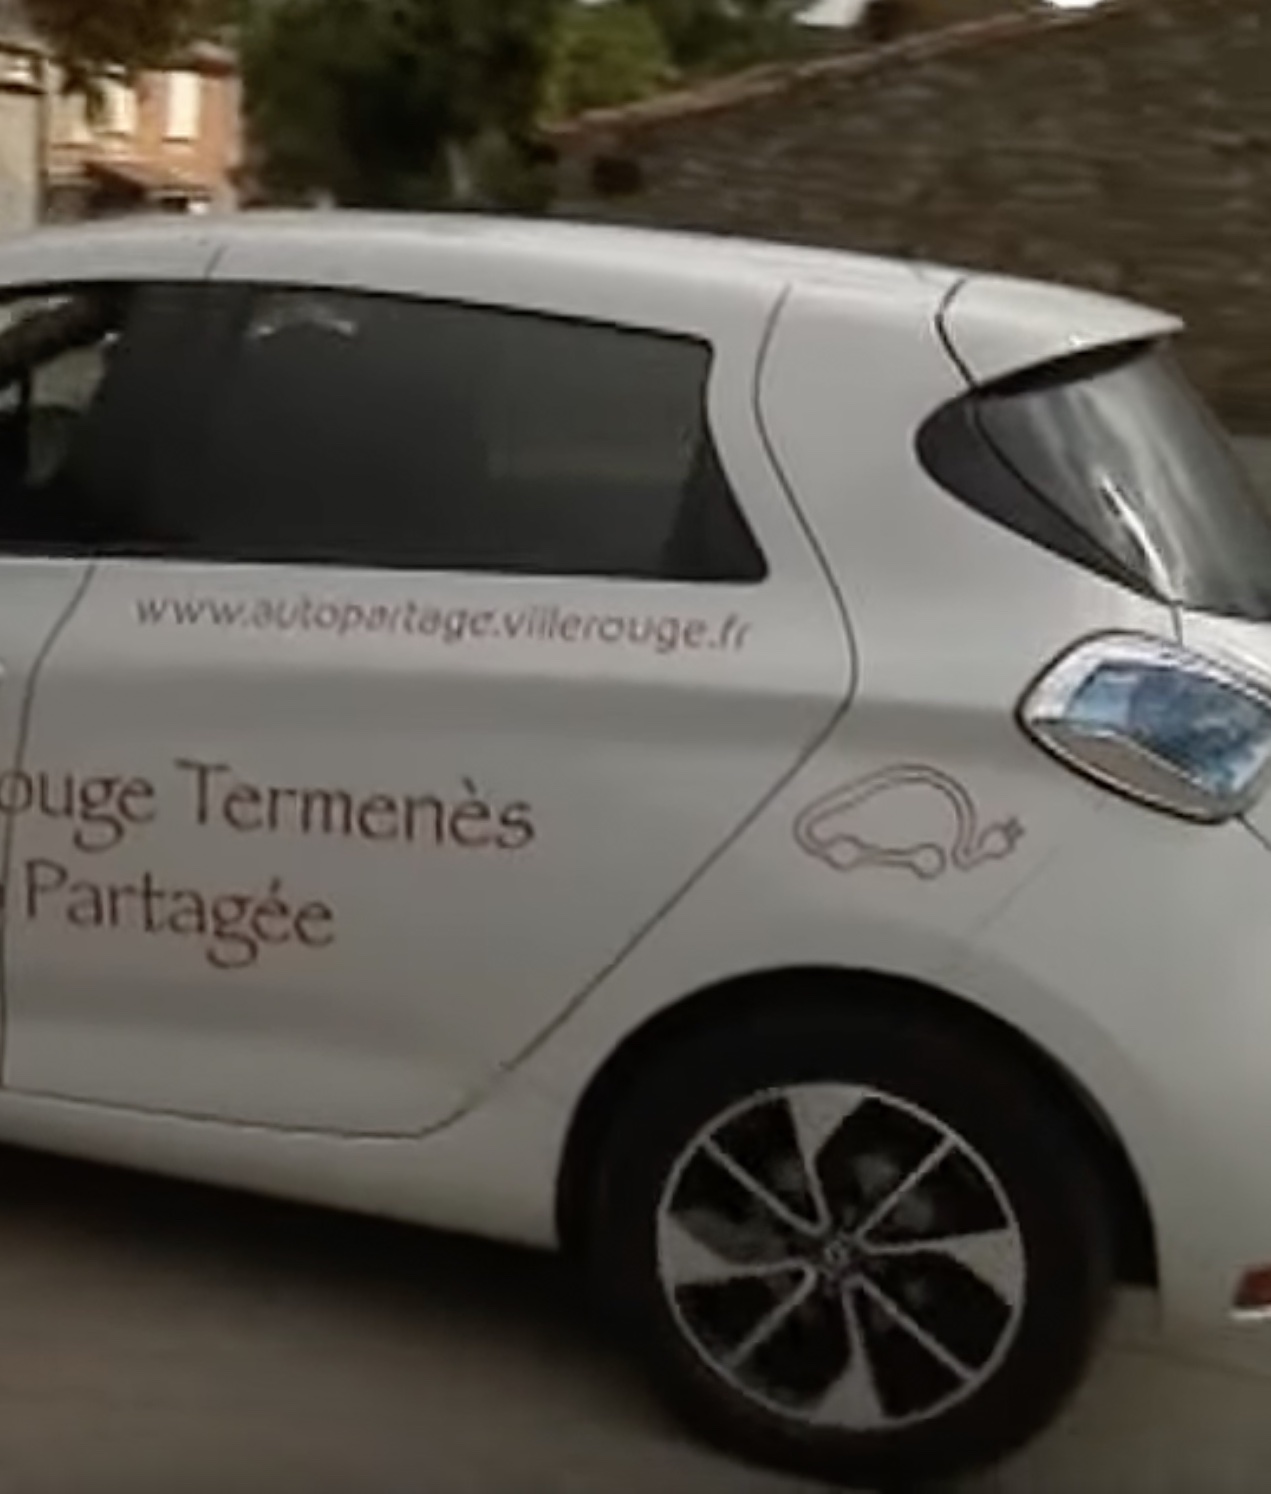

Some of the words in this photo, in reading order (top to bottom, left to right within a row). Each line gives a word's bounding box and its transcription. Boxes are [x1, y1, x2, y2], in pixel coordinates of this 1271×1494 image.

[135, 596, 751, 653] www.autopartage.villerouge.fr
[174, 758, 536, 850] Termenès
[25, 858, 335, 970] Partagée
